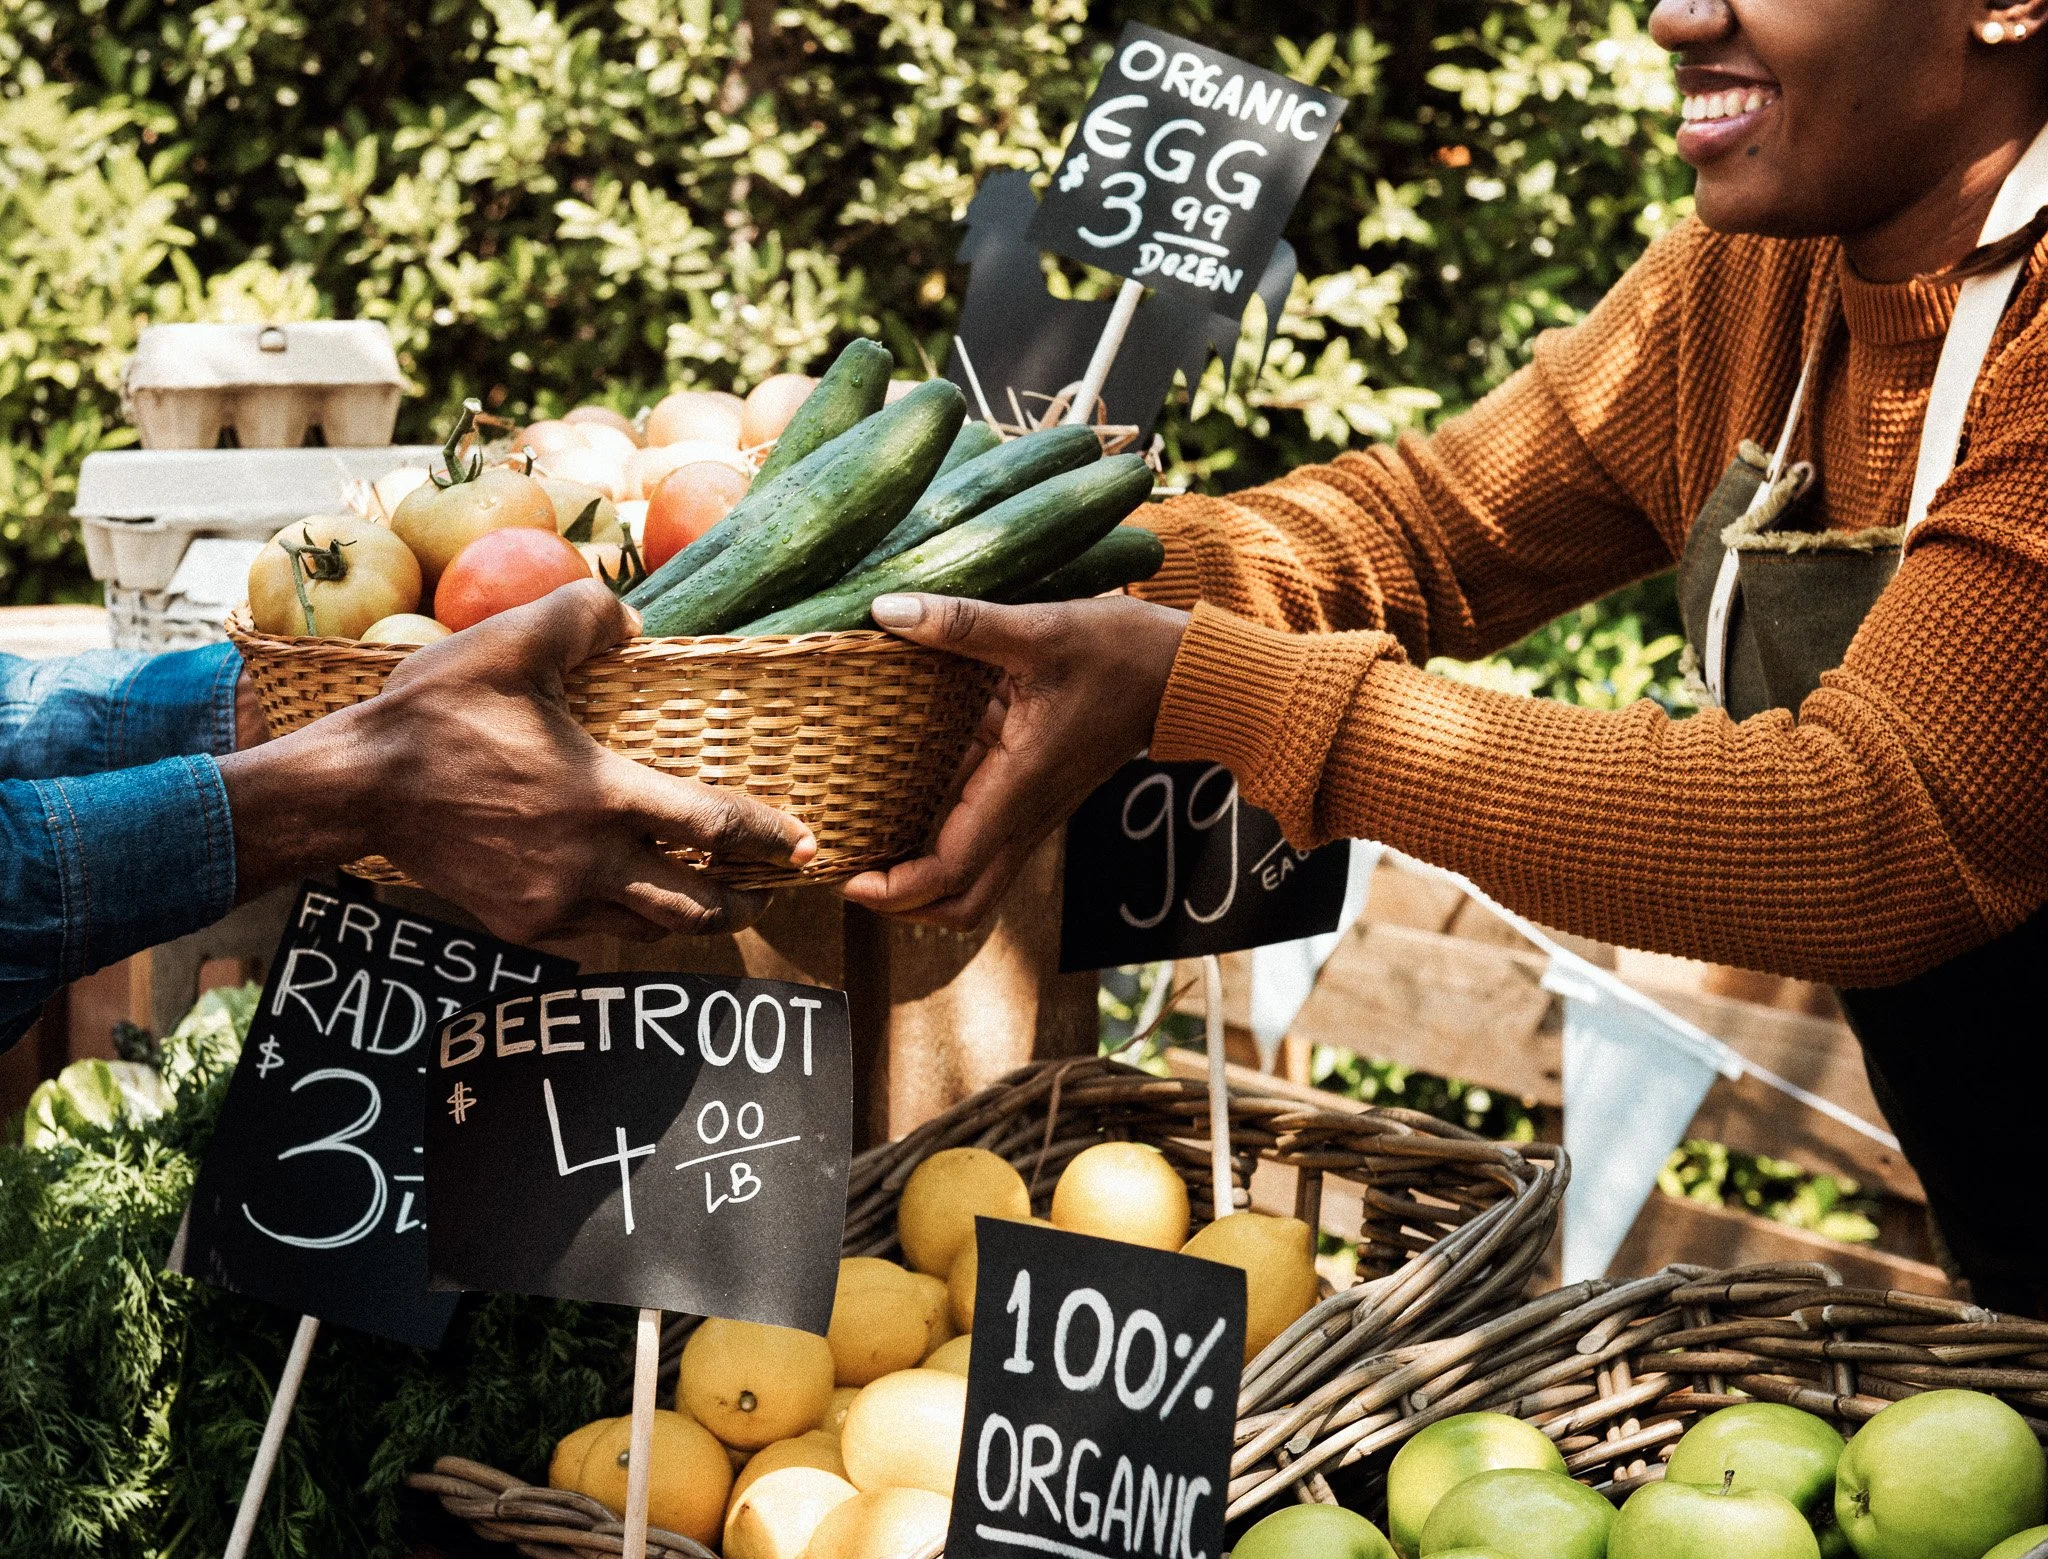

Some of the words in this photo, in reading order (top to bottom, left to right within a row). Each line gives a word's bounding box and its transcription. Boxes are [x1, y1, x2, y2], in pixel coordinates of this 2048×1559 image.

[1119, 39, 1327, 142] ORGANIC
[1083, 94, 1269, 211] EGG
[1132, 242, 1244, 294] DOZEN
[1171, 196, 1232, 242] 99
[298, 891, 542, 992] FRESH
[271, 948, 461, 1056] RAD
[439, 983, 822, 1077] BEETROOT
[242, 1067, 388, 1250] 3
[445, 1080, 478, 1125] $
[544, 1077, 656, 1235] 4
[704, 1162, 763, 1214] LB
[1003, 1268, 1227, 1422] 100%
[976, 1412, 1212, 1559] ORGANIC
